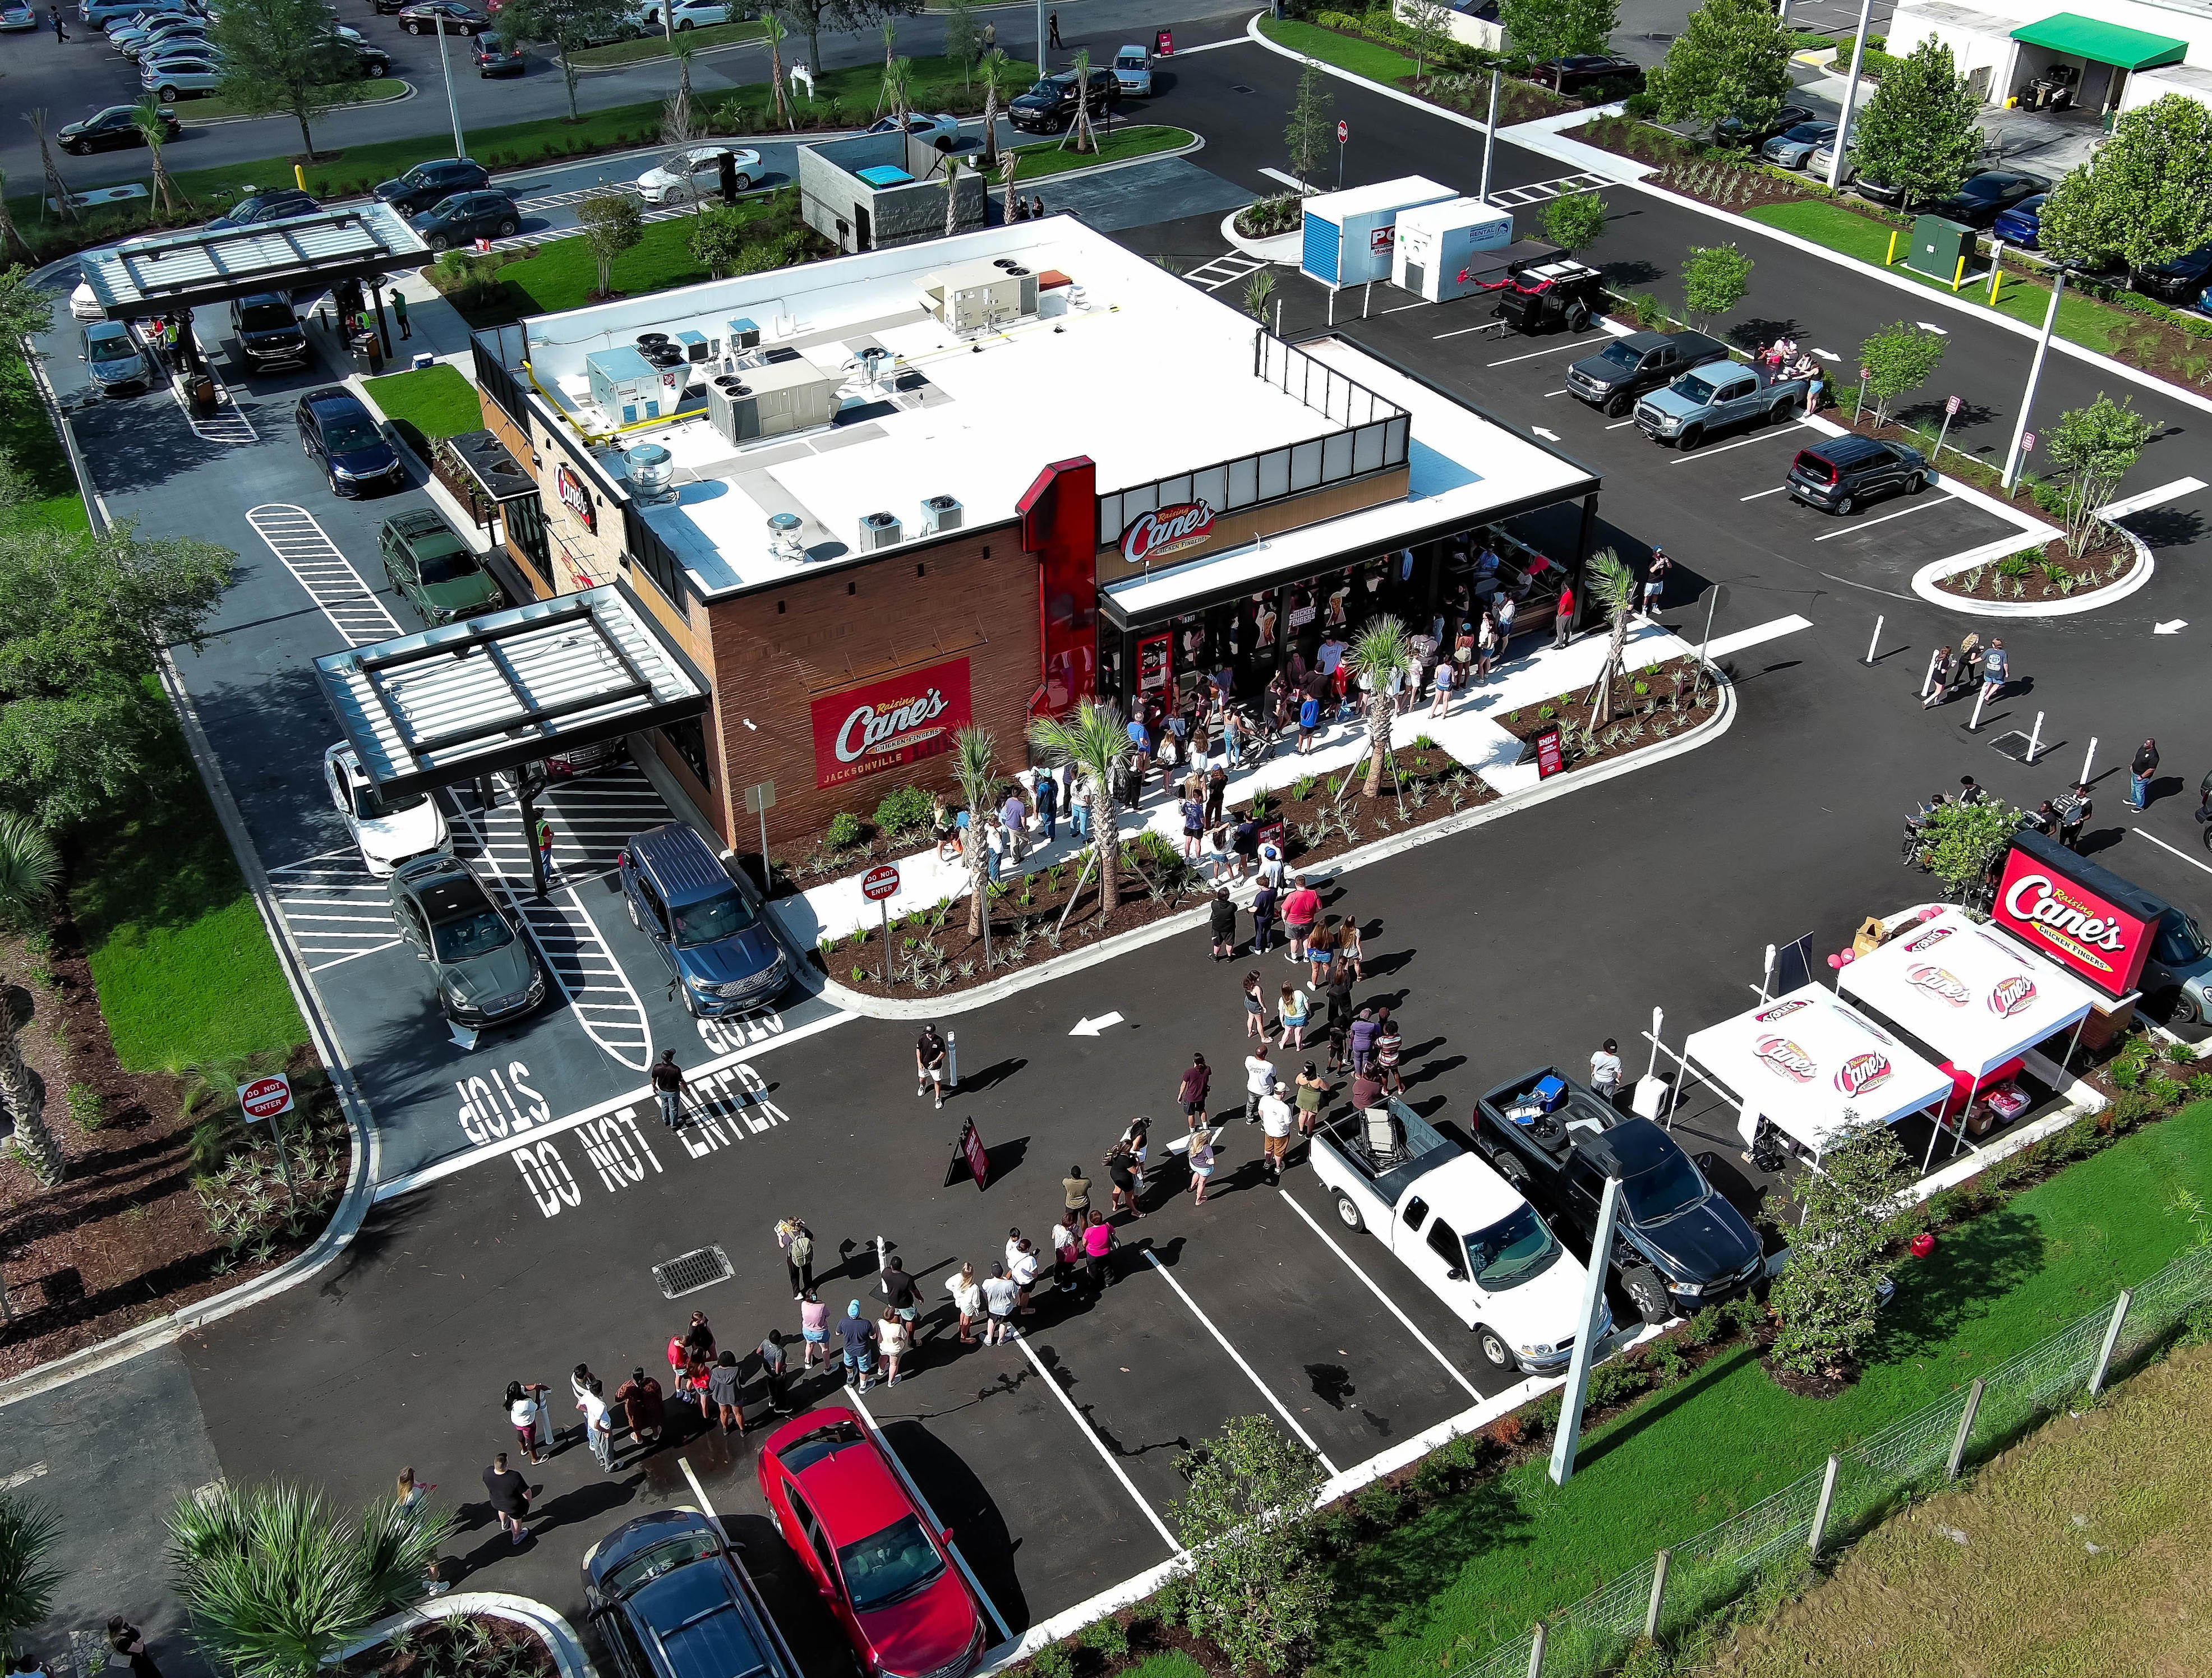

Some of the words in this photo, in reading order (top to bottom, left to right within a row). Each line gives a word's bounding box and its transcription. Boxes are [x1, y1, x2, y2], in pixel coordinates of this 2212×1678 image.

[1469, 228, 1495, 238] RENTAL
[555, 463, 587, 515] Cane's
[1157, 507, 1190, 523] Raising
[1125, 500, 1216, 563] Cane's
[1288, 614, 1315, 626] FINGERS
[1289, 607, 1316, 620] CHICKEN
[875, 696, 916, 716] Raising
[835, 688, 949, 762] Cane's
[875, 737, 906, 752] CHICKEN
[908, 729, 940, 742] FINGERS
[823, 753, 902, 783] JACKSONVILLE
[880, 869, 894, 878] NOT
[871, 885, 893, 896] ENTER
[2005, 874, 2126, 953] Cane's
[2052, 888, 2095, 918] Raising
[2039, 925, 2070, 948] CHICKEN
[247, 1090, 259, 1098] DO
[263, 1082, 280, 1093] NOT
[254, 1099, 282, 1113] ENTER
[455, 1060, 551, 1146] STOP
[510, 1140, 582, 1219] DO
[573, 1106, 664, 1193] NOT
